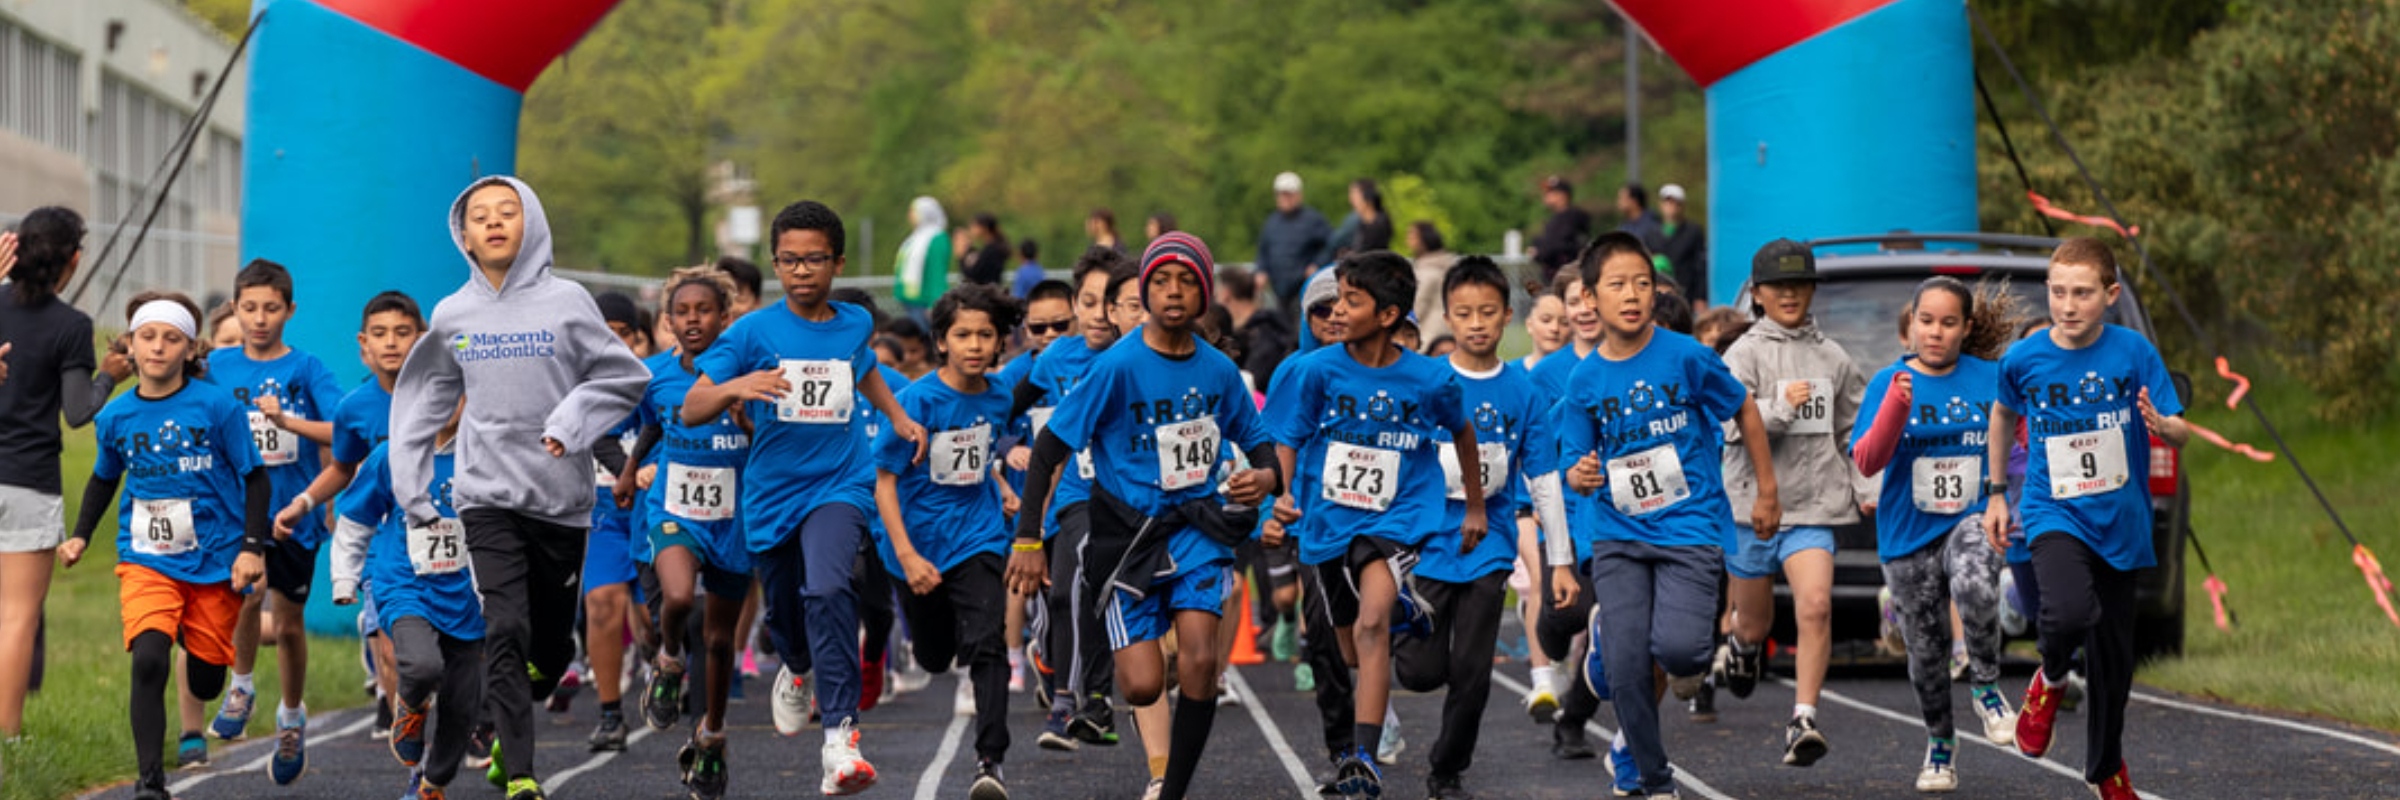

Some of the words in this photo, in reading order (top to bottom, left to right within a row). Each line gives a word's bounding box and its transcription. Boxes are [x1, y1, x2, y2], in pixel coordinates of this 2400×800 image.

[473, 329, 555, 345] Macomb
[456, 344, 555, 361] rthodontics
[801, 380, 833, 407] 87
[1796, 396, 1826, 420] 66
[1961, 430, 1989, 446] RU
[951, 444, 981, 472] 76
[1172, 436, 1214, 472] 148
[2080, 451, 2098, 479] 9
[1336, 462, 1385, 496] 173
[1629, 469, 1664, 499] 81
[1933, 474, 1963, 499] 83
[678, 482, 723, 508] 143
[147, 516, 174, 542] 69
[426, 534, 458, 561] 75
